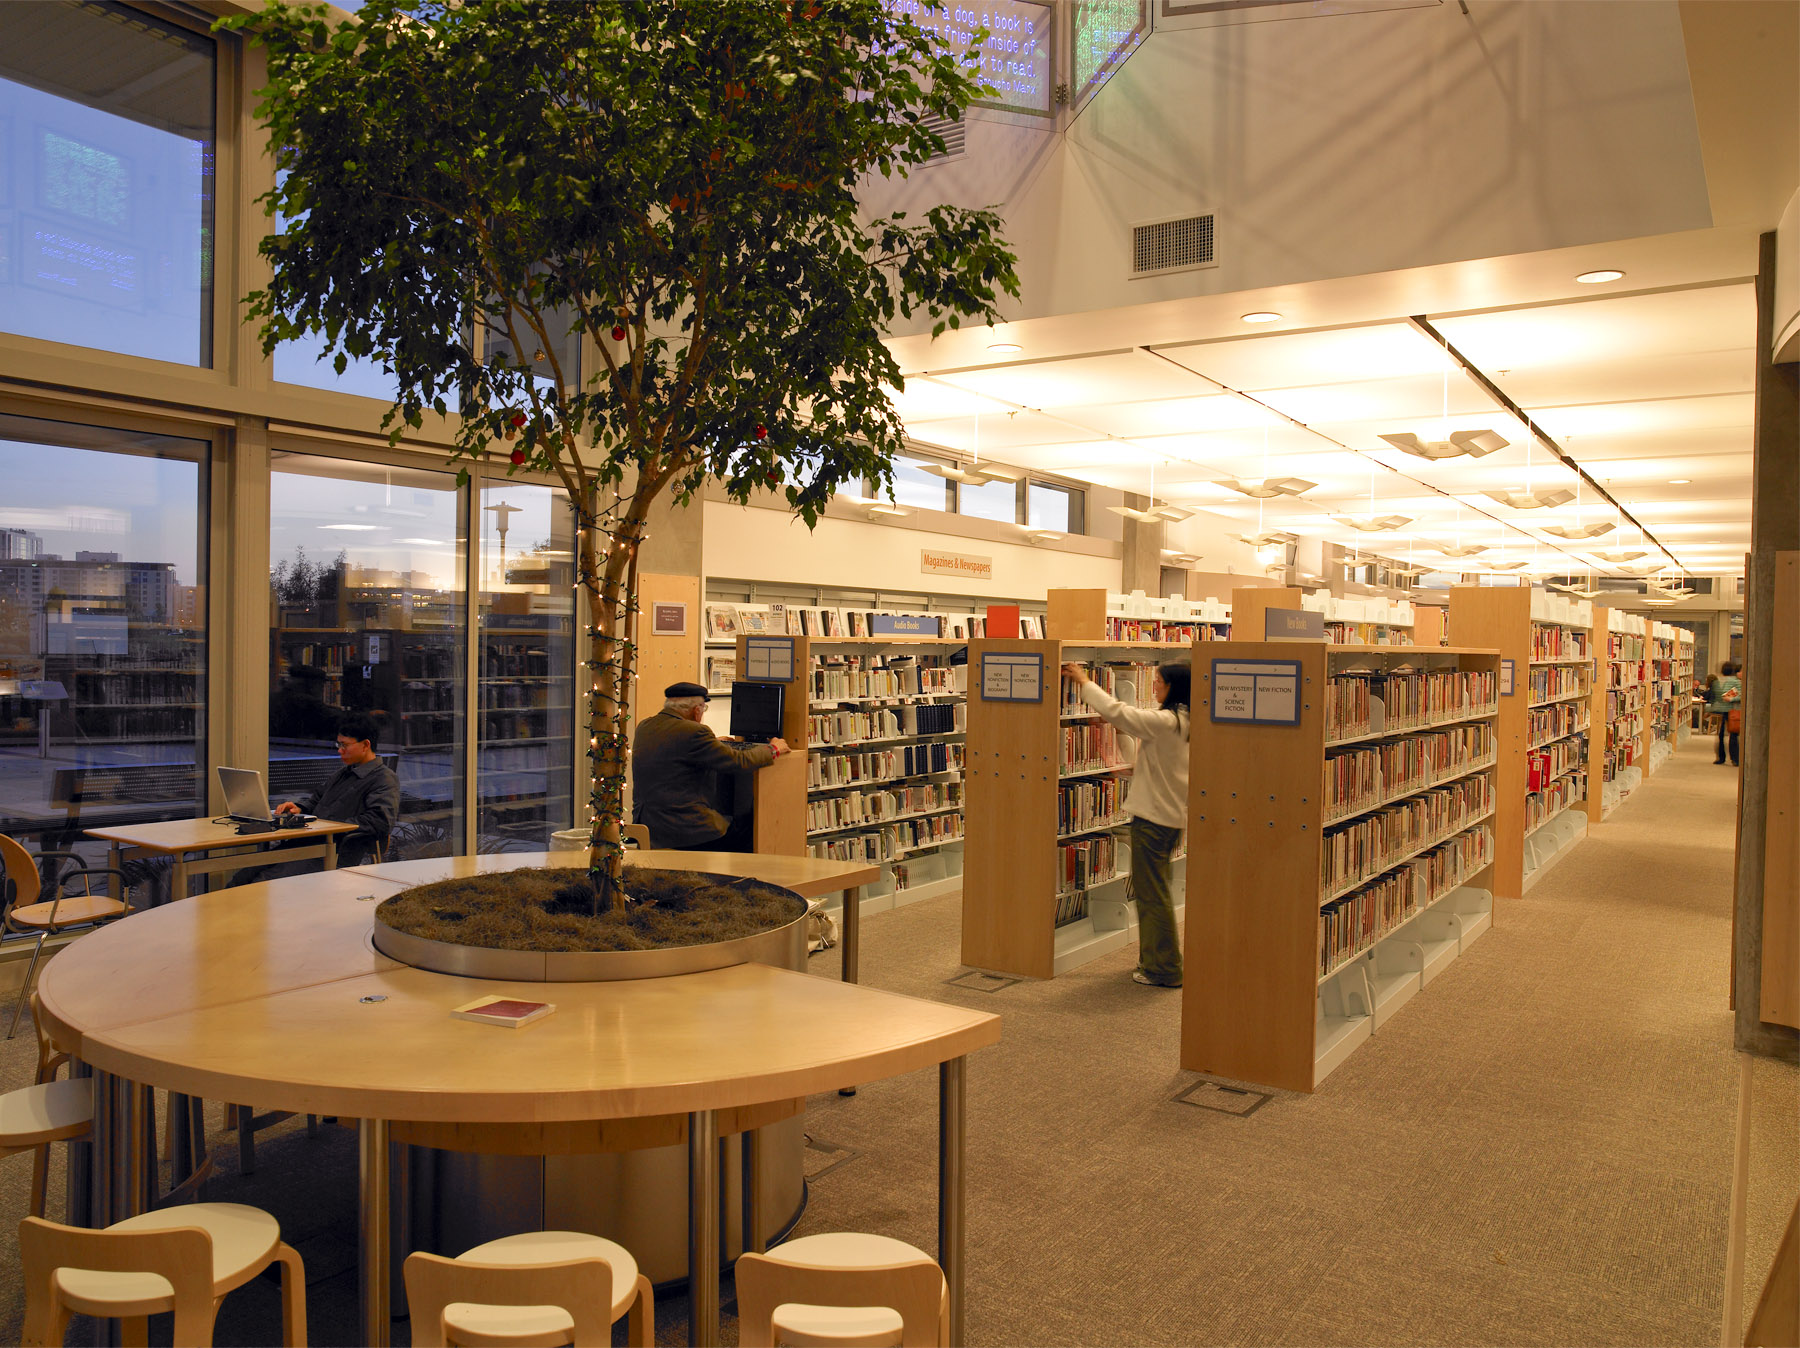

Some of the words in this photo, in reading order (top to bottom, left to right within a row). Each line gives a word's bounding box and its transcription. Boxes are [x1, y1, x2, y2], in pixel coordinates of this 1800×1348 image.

[880, 0, 919, 15] utside
[942, 6, 950, 20] a
[955, 5, 978, 27] dog,
[982, 13, 990, 27] a
[994, 11, 1020, 32] book
[1024, 16, 1034, 35] is
[1023, 39, 1036, 56] of
[991, 55, 1003, 72] to
[1007, 60, 1036, 78] read.
[1014, 80, 1036, 94] Marx
[924, 553, 954, 569] Magazines
[954, 557, 959, 569] &
[960, 558, 991, 574] Newspapers
[772, 604, 783, 612] 102
[894, 620, 906, 630] Audio
[907, 620, 919, 630] Books
